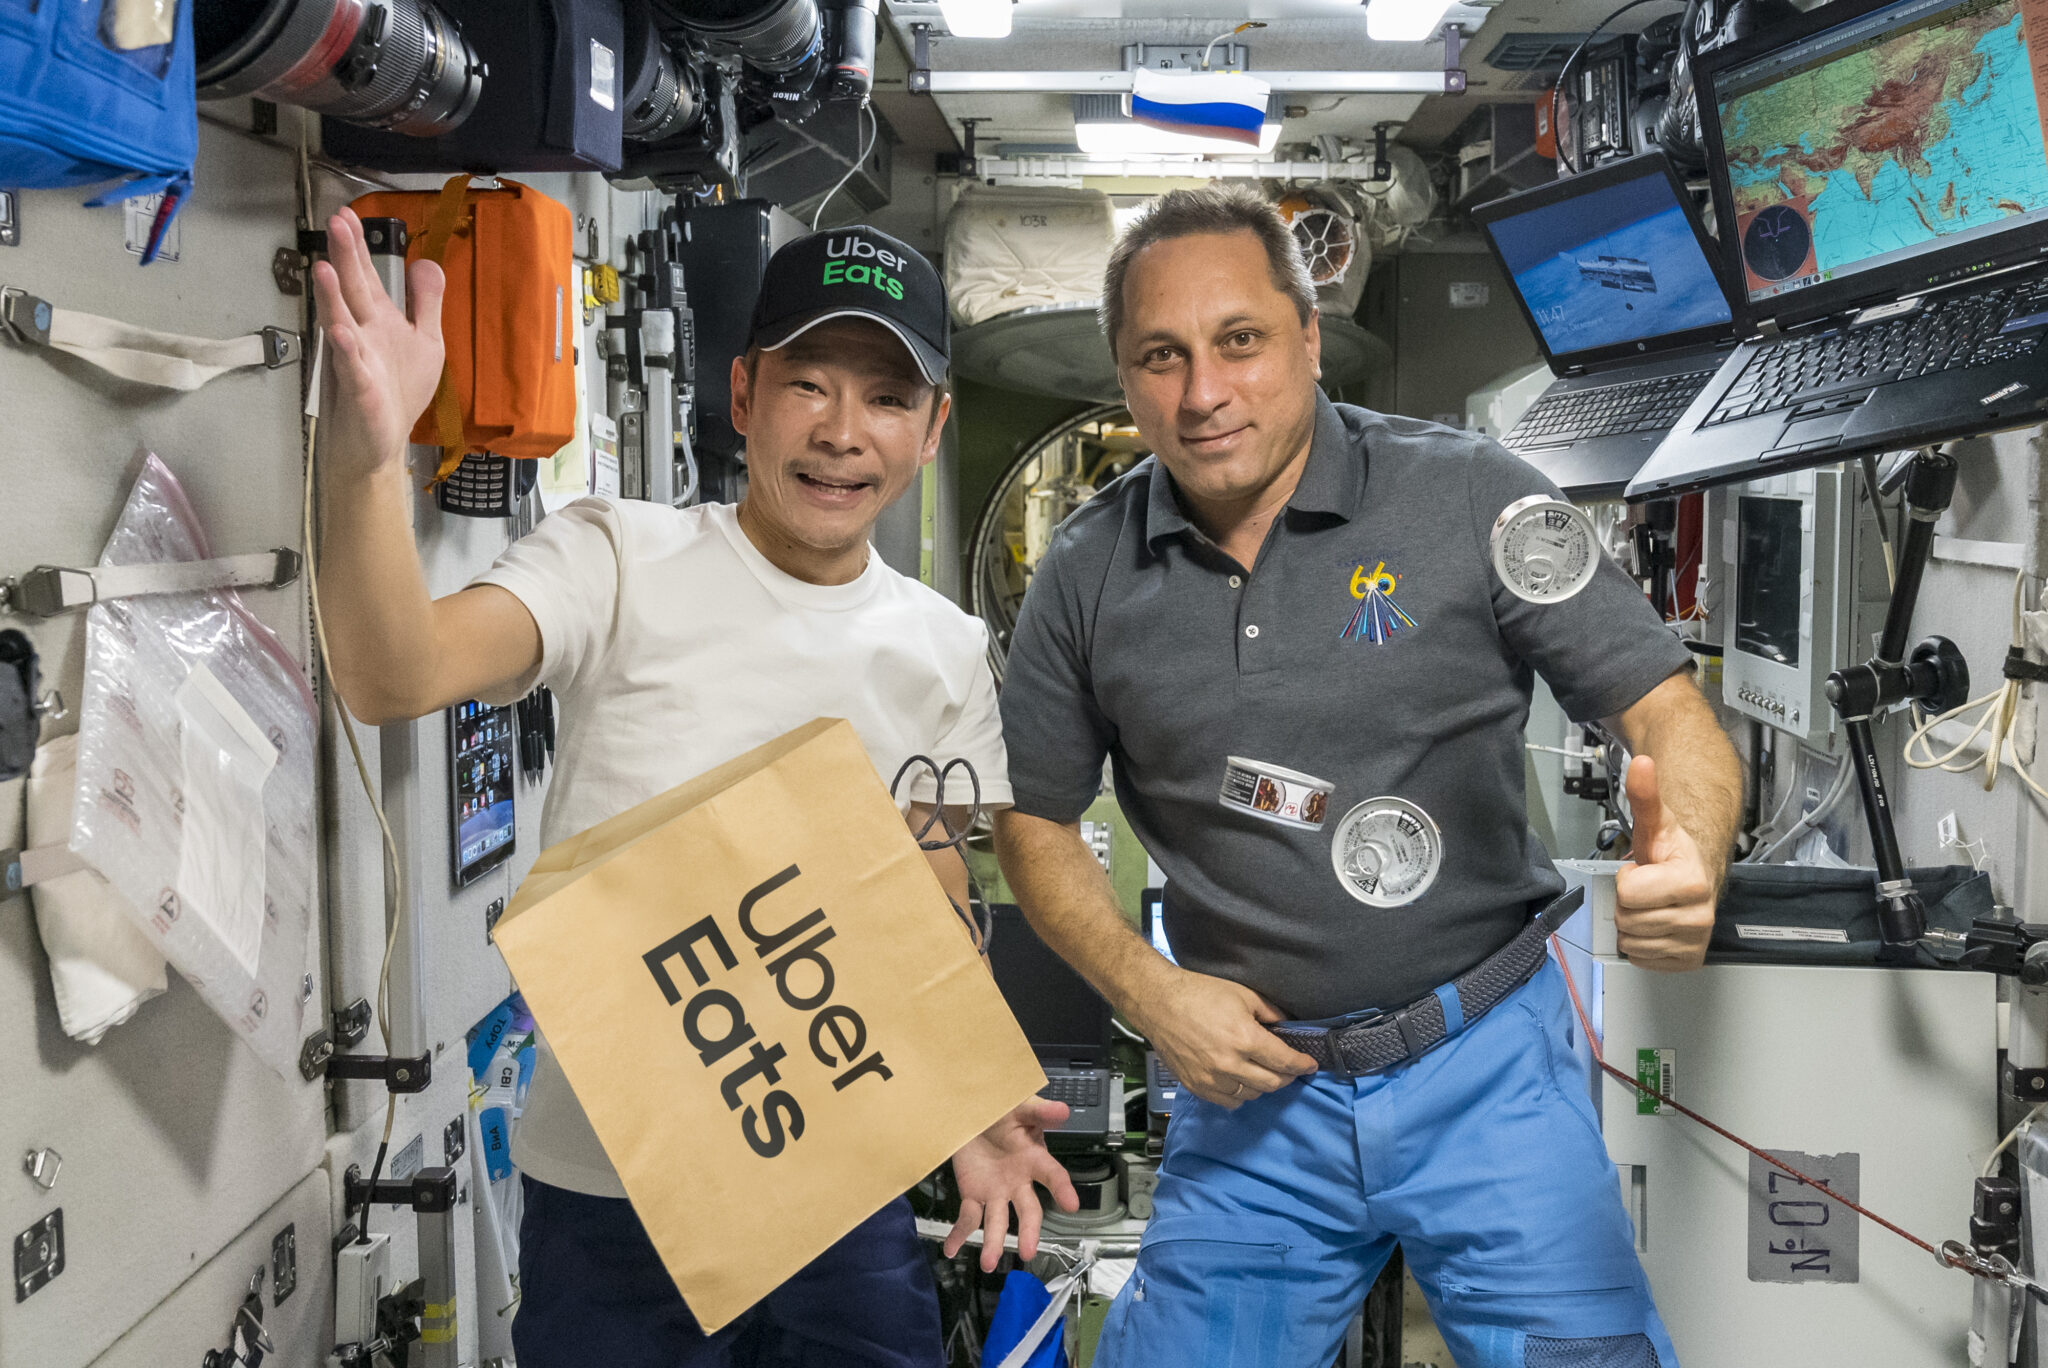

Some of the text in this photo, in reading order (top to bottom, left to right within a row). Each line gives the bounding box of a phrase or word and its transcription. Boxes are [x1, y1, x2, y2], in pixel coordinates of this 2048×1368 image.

[772, 91, 800, 101] Nikon
[826, 237, 908, 273] Uber
[822, 260, 905, 301] Eats
[1982, 382, 2022, 406] ThinkPad
[1349, 560, 1396, 600] 66
[738, 863, 894, 1093] Uber
[641, 914, 806, 1159] Eats
